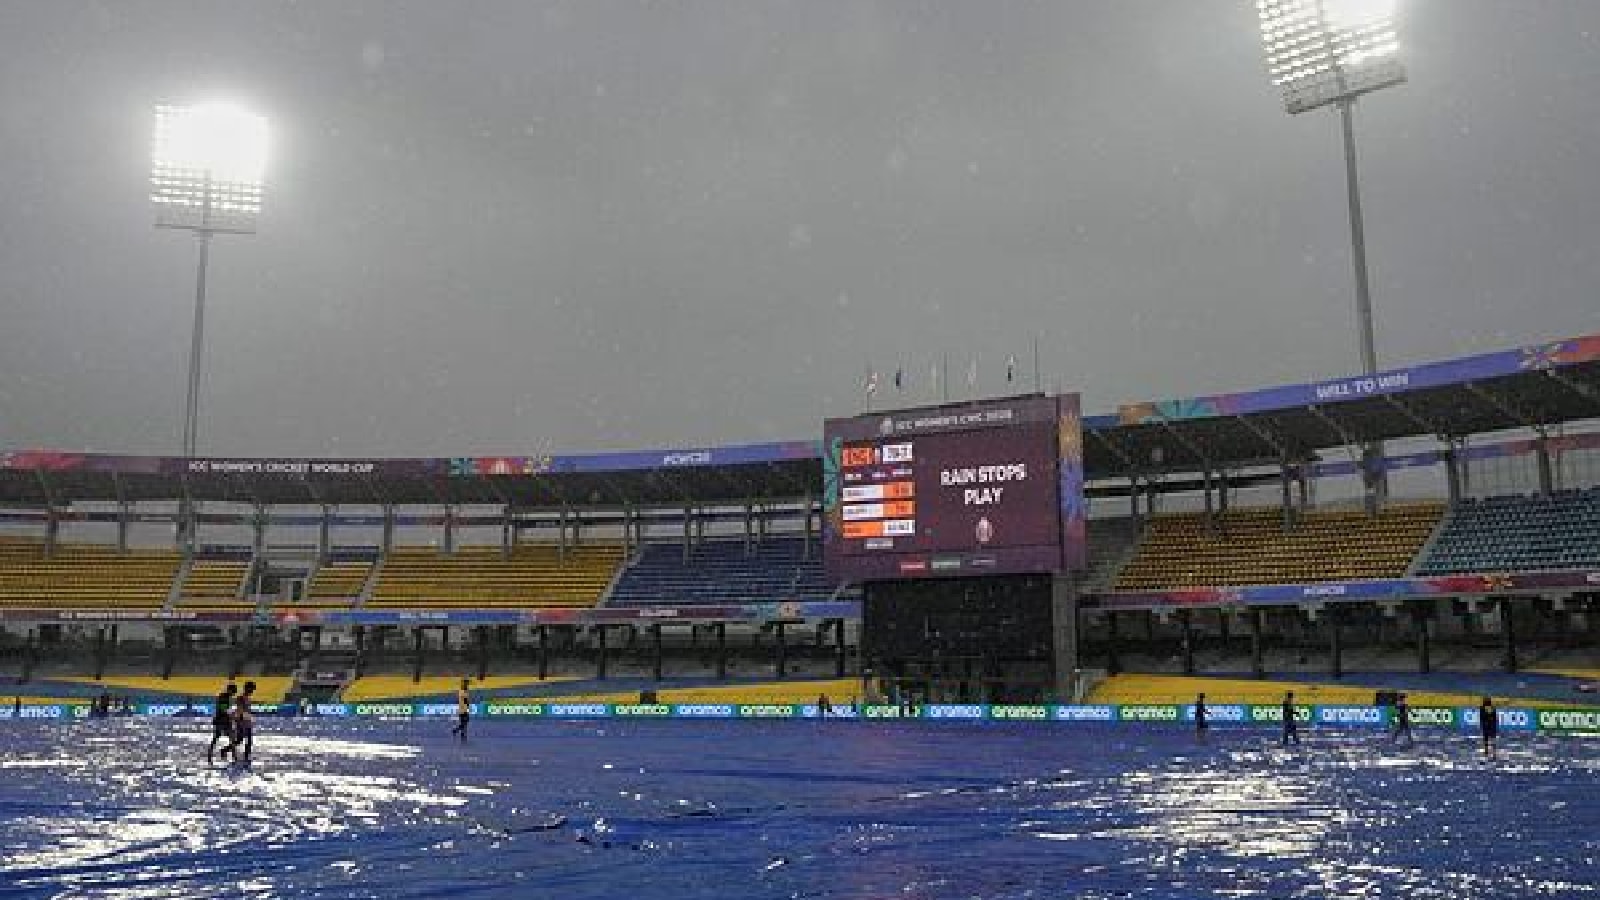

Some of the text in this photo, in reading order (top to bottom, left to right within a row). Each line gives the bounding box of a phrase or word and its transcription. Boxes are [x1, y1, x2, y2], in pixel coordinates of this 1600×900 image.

[1317, 374, 1409, 398] WILL TO WIN
[941, 463, 1027, 485] RAIN STOPS
[964, 488, 1004, 504] PLAY
[356, 704, 412, 715] aramco
[423, 704, 479, 715] aramo
[487, 704, 542, 715] aramco
[551, 704, 606, 715] aramco
[615, 704, 670, 715] aramco
[679, 704, 732, 715] aramco
[740, 704, 793, 715] aramco
[931, 705, 982, 718] aramco
[992, 705, 1046, 718] aramco
[1056, 706, 1111, 719] aramco
[1121, 706, 1177, 720] aramco
[1322, 708, 1380, 721] aramco
